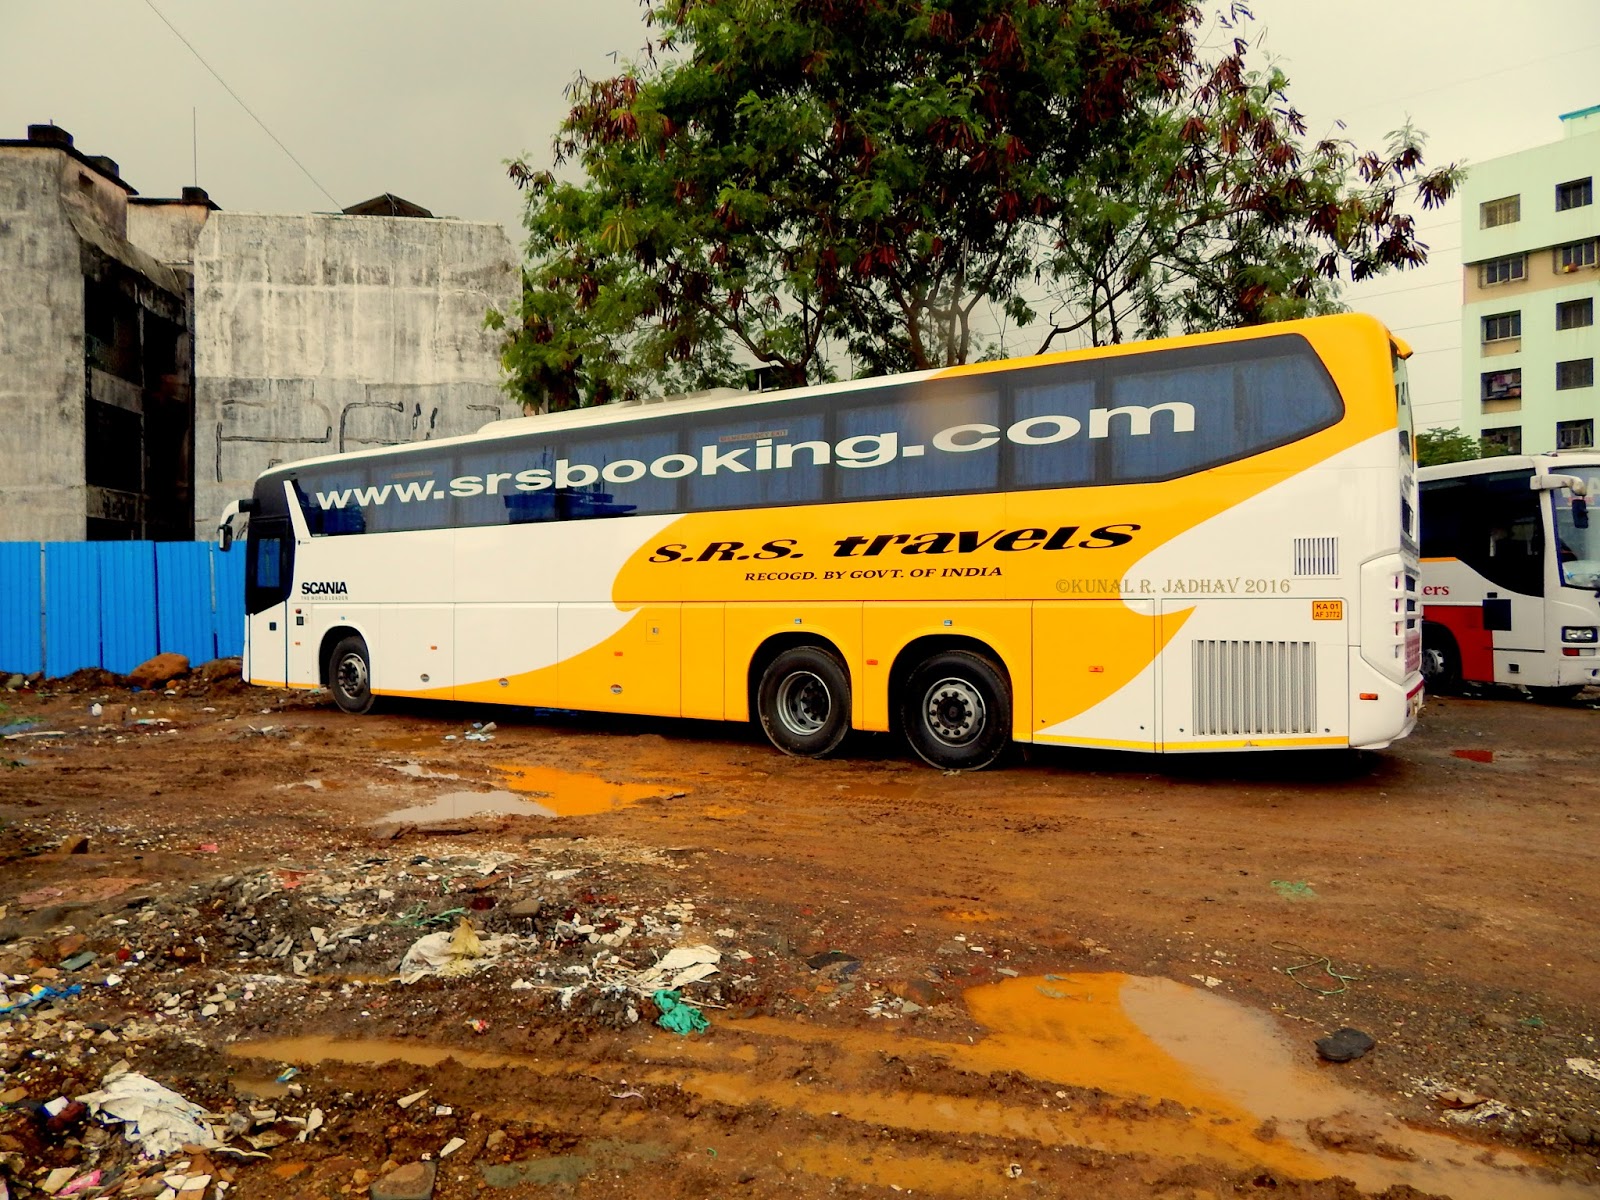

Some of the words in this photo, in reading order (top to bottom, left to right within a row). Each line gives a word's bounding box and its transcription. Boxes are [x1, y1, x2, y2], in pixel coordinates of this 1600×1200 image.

[316, 401, 1195, 510] www.srsbooking.com
[648, 539, 804, 563] S.R.S.
[833, 524, 1141, 558] travels
[744, 571, 818, 582] RECOGD.
[823, 570, 847, 580] BY
[849, 569, 904, 580] GOVT.
[909, 568, 937, 578] OF
[940, 566, 1003, 578] INDIA
[301, 582, 348, 595] SCANIA
